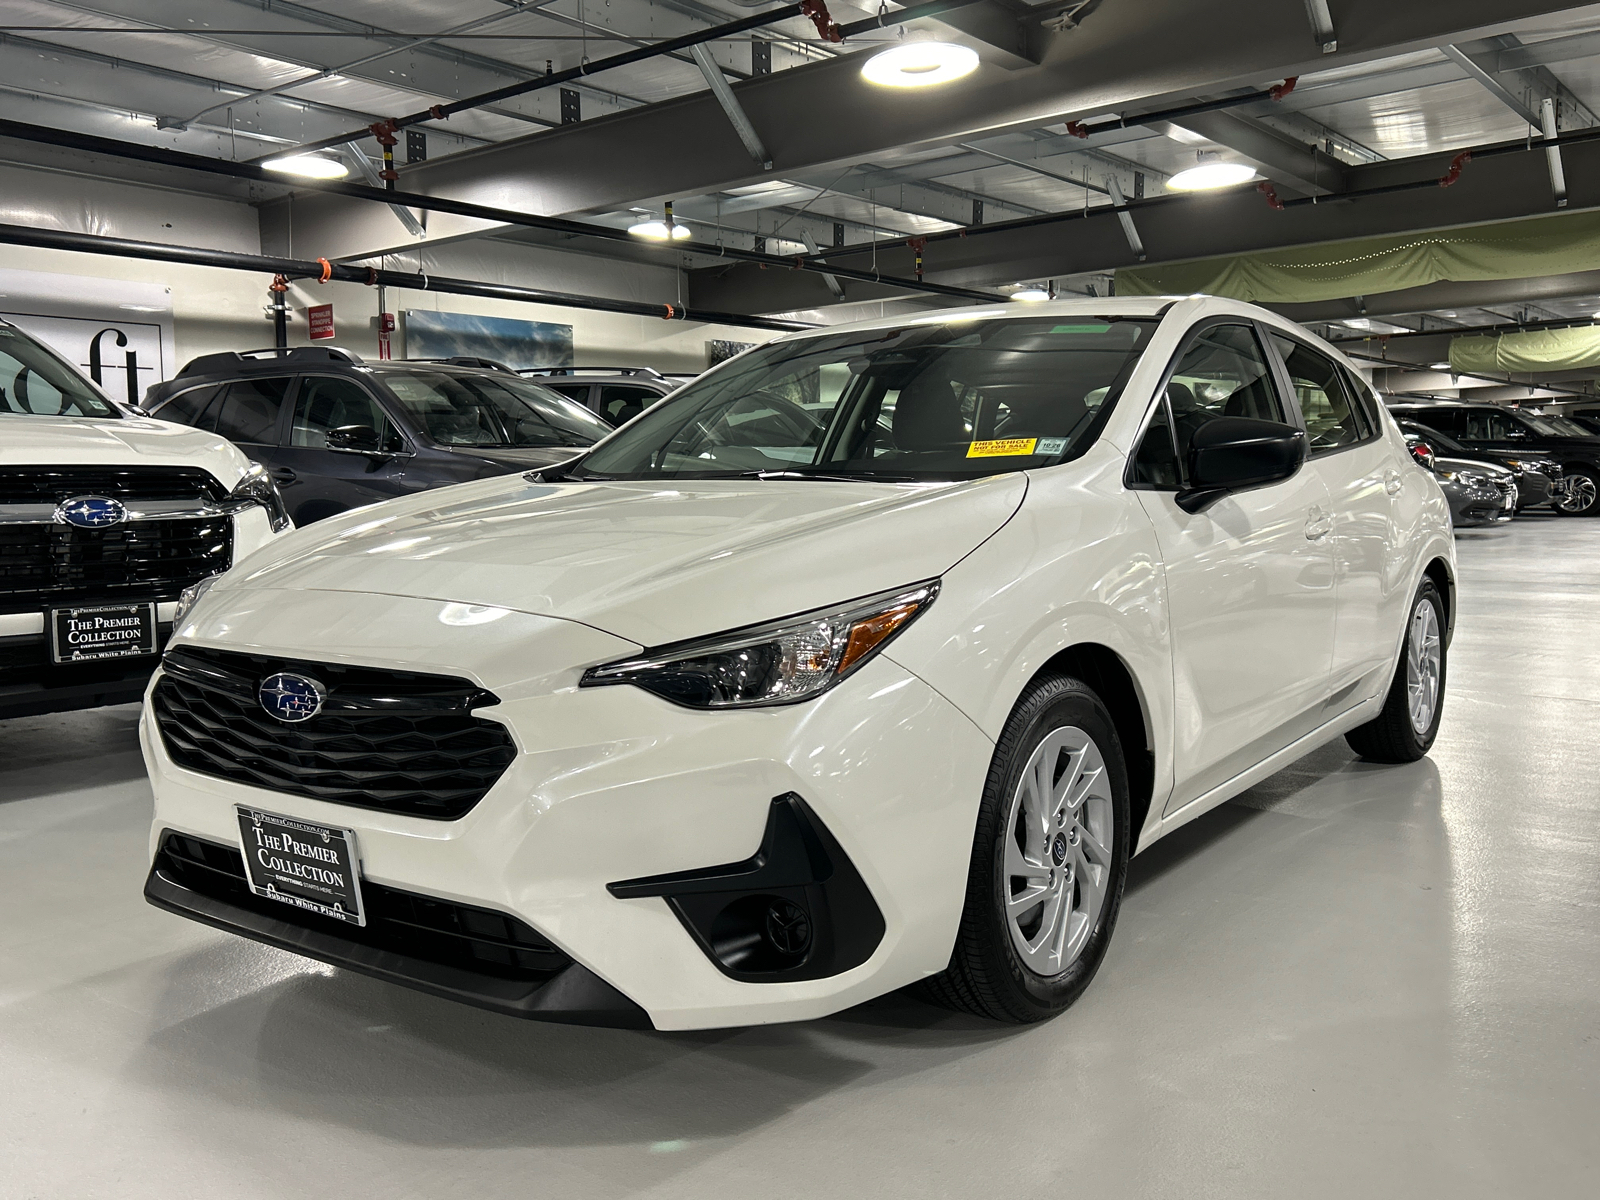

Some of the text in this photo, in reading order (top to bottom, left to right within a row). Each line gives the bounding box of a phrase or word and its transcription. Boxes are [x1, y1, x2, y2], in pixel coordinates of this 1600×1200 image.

[311, 310, 331, 319] SPRINKLER
[310, 325, 333, 333] CONNECTION
[312, 318, 331, 326] STANDPIPE
[67, 617, 141, 631] THE PREMIER
[67, 629, 141, 644] COLLECTION
[252, 826, 340, 865] THE PREMIER
[257, 848, 345, 888] COLLECTION
[275, 874, 303, 886] EVERYTHING
[266, 890, 346, 920] Subaru White Plains
